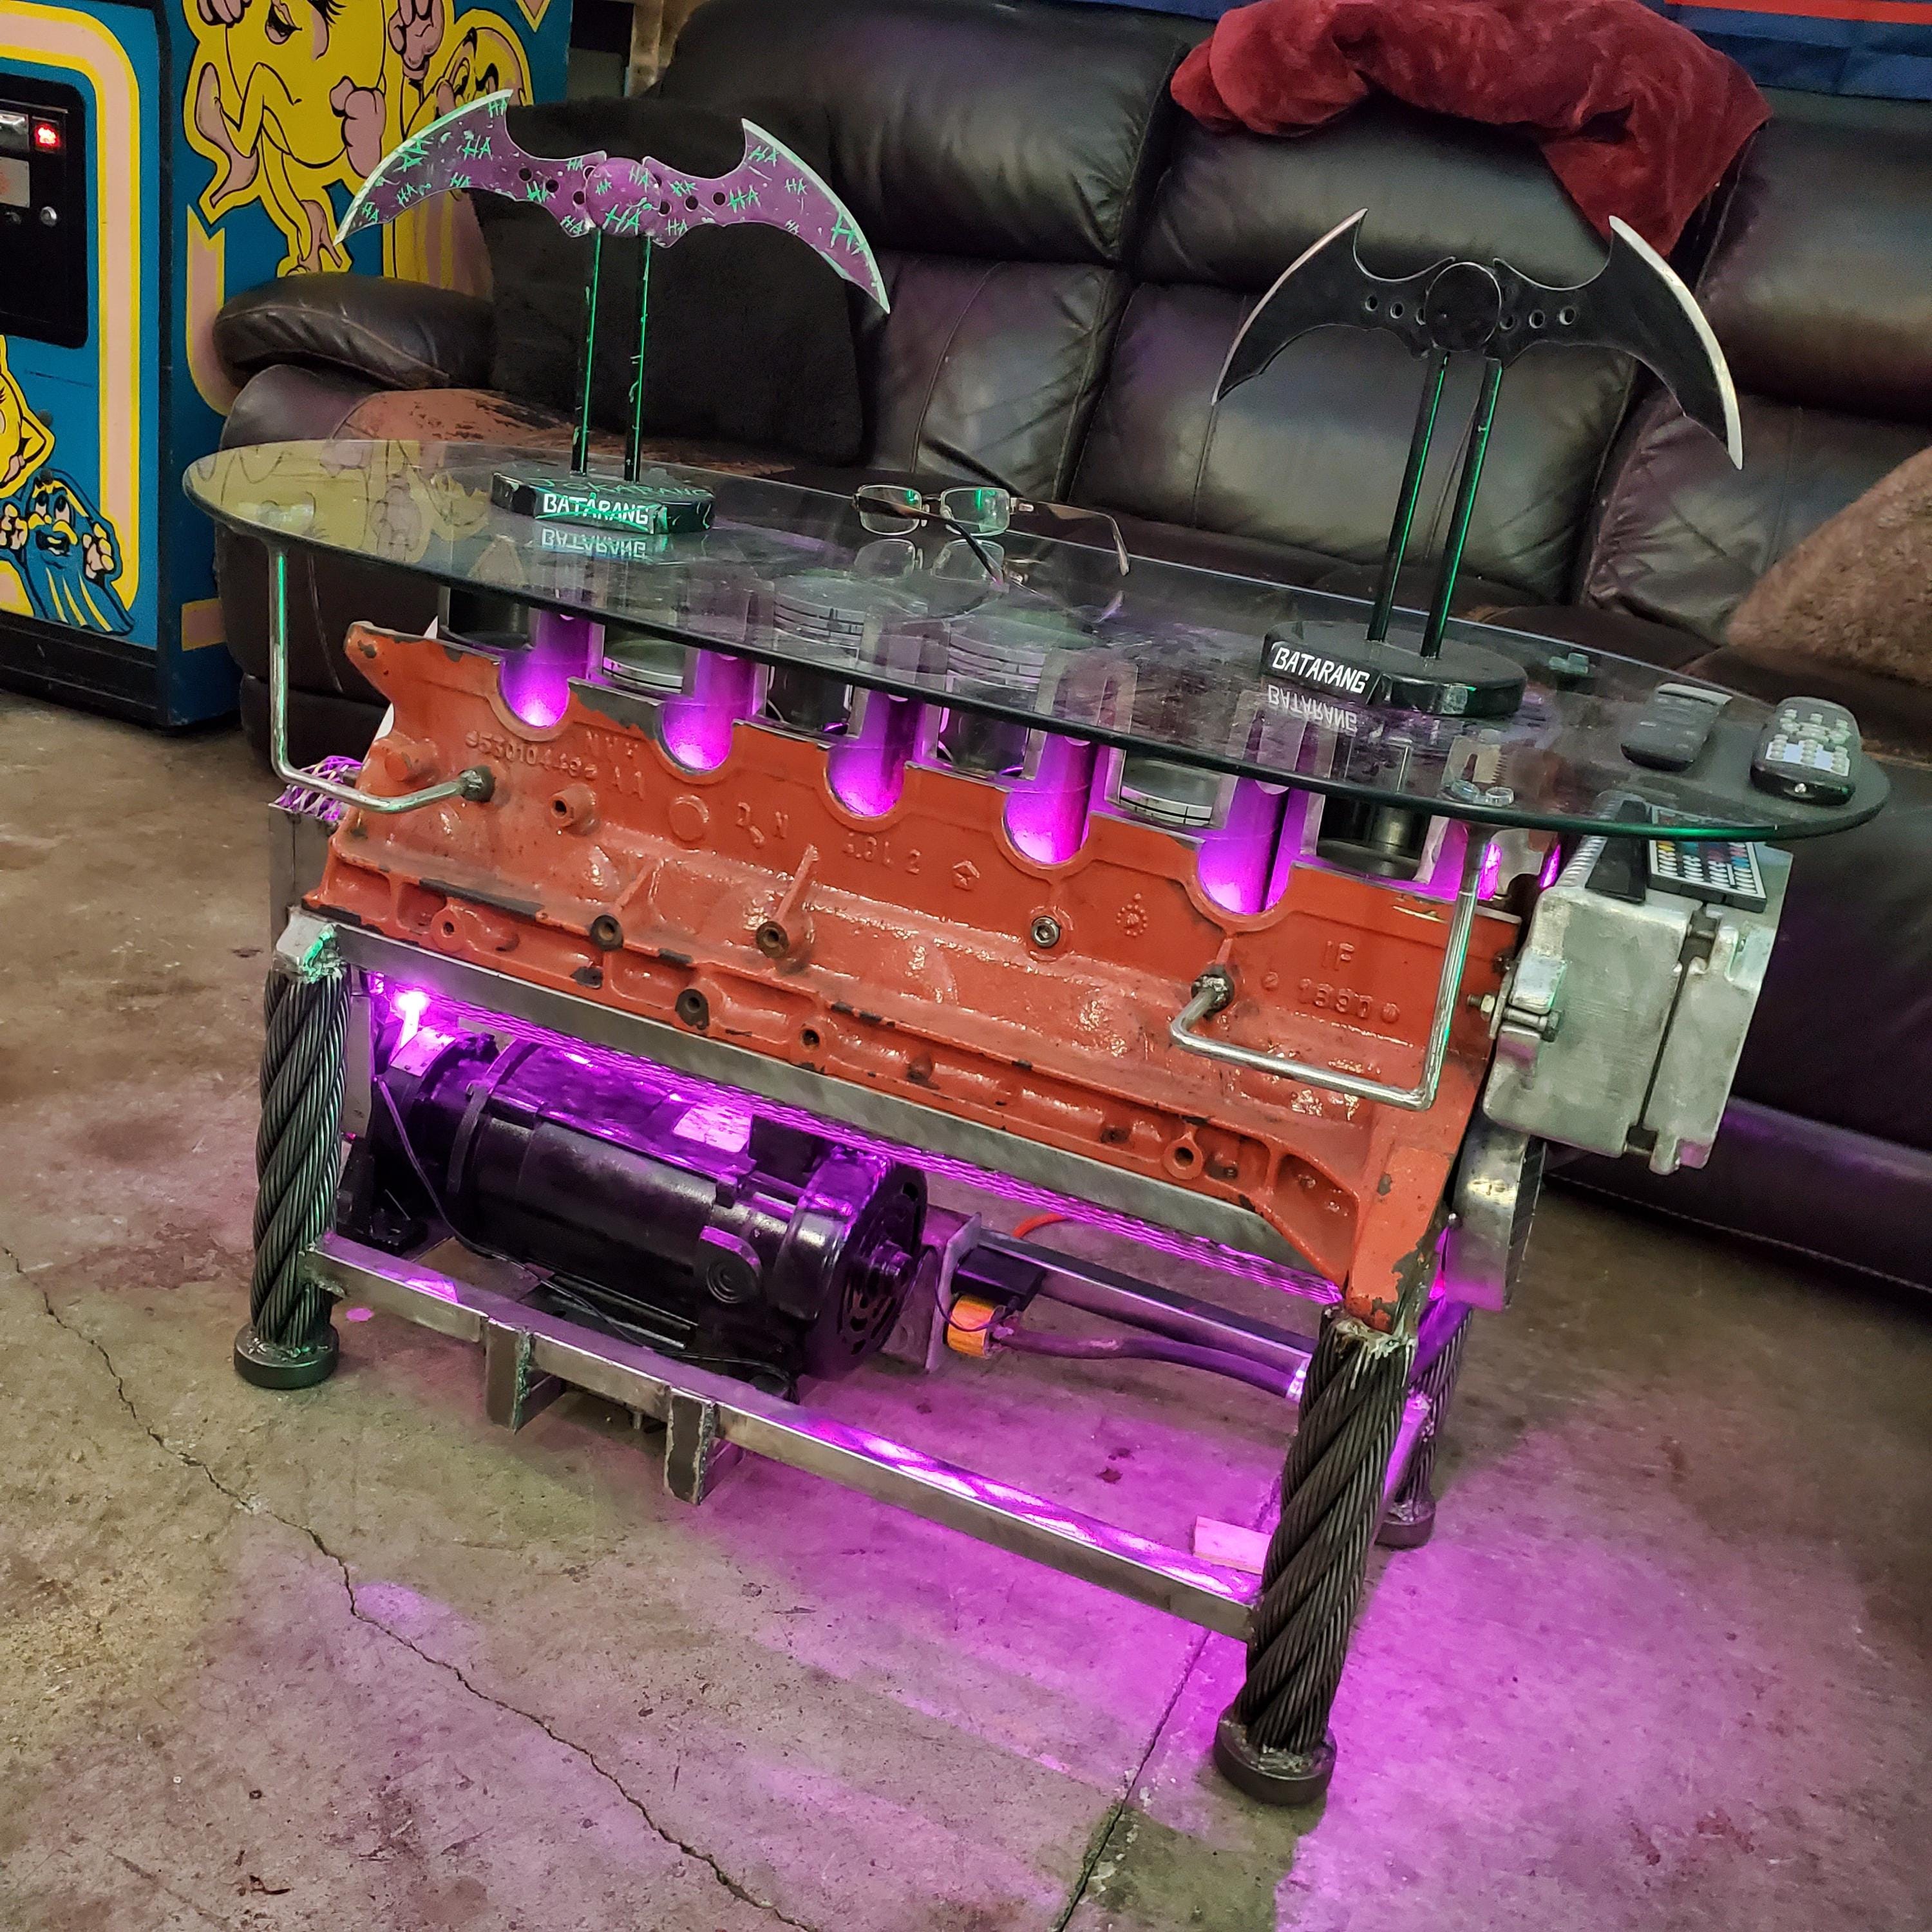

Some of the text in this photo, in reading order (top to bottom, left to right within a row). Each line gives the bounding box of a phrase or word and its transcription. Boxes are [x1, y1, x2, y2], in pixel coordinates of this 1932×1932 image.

[462, 135, 493, 161] HA
[629, 165, 649, 193] HA
[785, 177, 807, 195] HA
[728, 185, 761, 213] HA
[602, 204, 642, 236] HA
[666, 217, 688, 236] HA
[785, 220, 800, 235] HA
[543, 493, 649, 525] BATARANG
[1271, 647, 1370, 694] BATARANG
